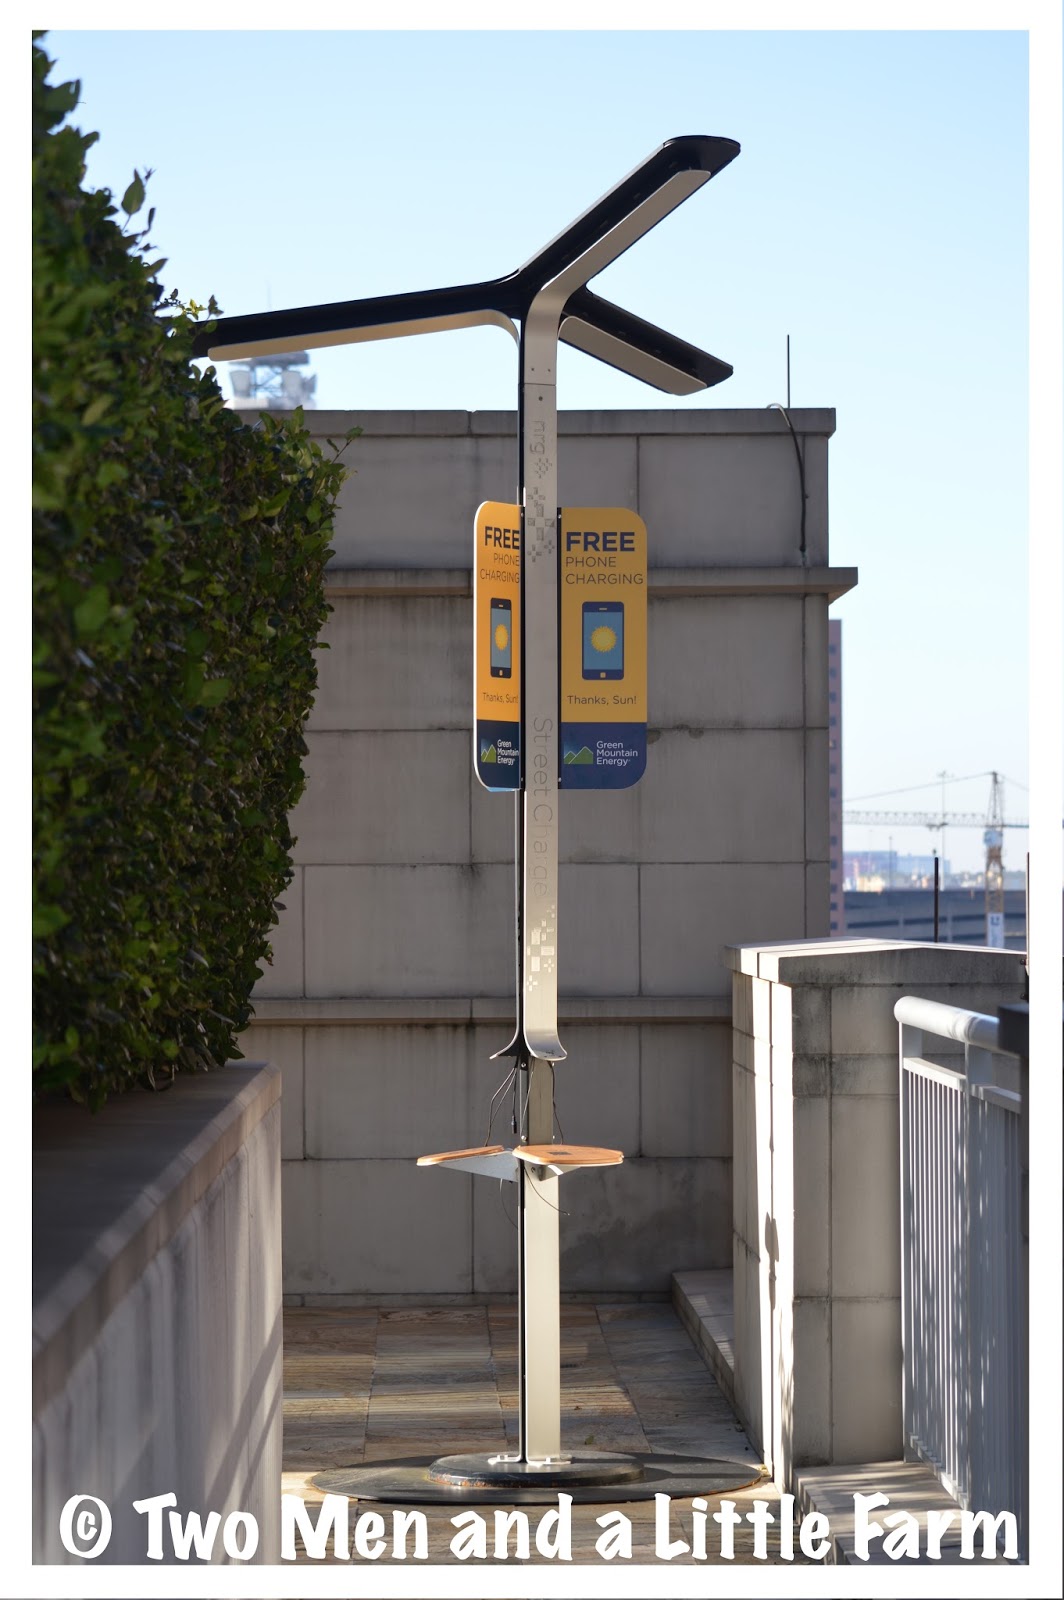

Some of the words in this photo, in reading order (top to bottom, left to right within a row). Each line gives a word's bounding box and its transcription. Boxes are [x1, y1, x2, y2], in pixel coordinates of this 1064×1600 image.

[484, 526, 520, 550] FREE
[566, 531, 636, 552] FREE
[493, 552, 520, 567] PHONE
[565, 556, 617, 568] PHONE
[479, 568, 520, 584] CHARGING
[565, 573, 644, 585] CHARGING
[482, 692, 505, 704] Thanks,
[505, 693, 519, 704] Sun!
[566, 695, 609, 706] Thanks,
[612, 695, 637, 705] Sun!
[497, 739, 512, 748] Green
[596, 740, 624, 749] Green
[497, 748, 520, 757] Mountain
[533, 716, 554, 797] Street
[596, 749, 639, 757] Mountain
[497, 756, 514, 766] Energy
[596, 757, 629, 767] Energy
[528, 803, 554, 897] Charge
